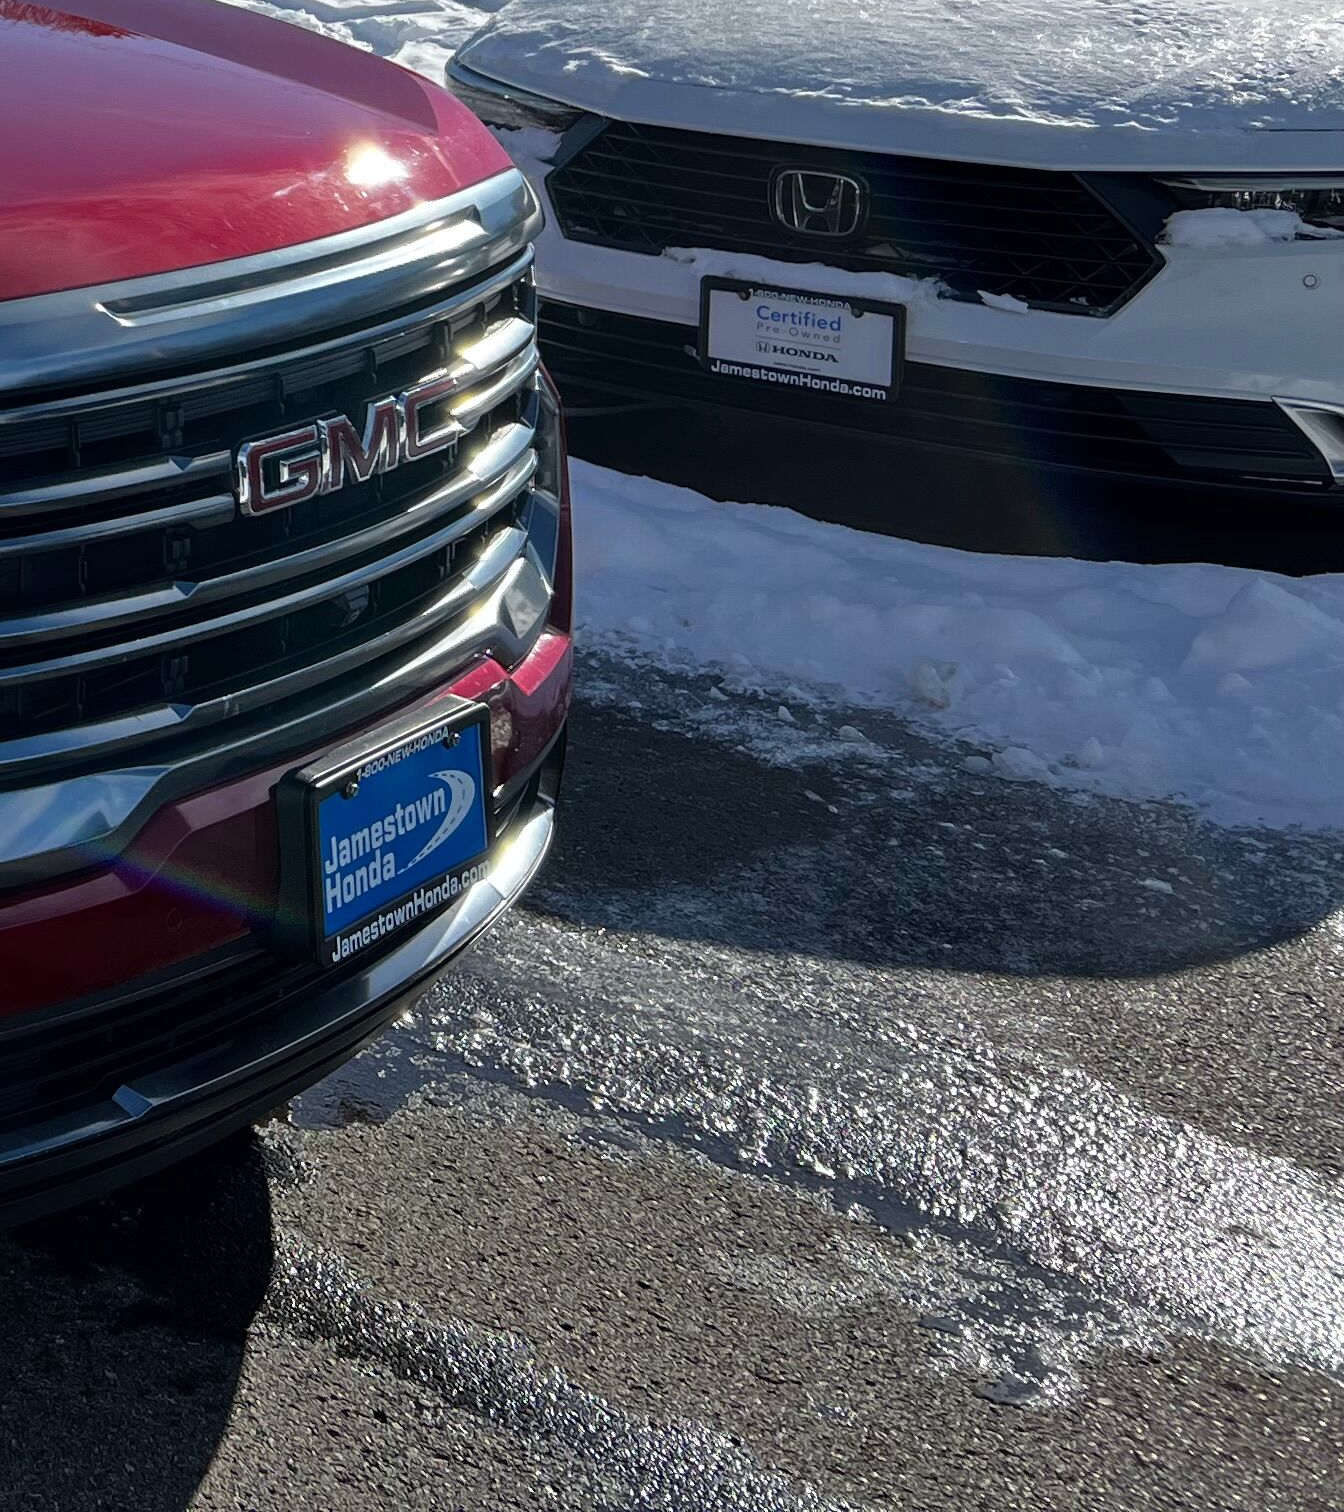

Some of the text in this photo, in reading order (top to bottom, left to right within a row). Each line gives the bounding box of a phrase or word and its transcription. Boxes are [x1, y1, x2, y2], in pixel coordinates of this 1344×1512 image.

[756, 305, 841, 331] Certified
[756, 321, 841, 344] Pre-Owned
[710, 359, 887, 401] JamestownHonda.com
[772, 345, 840, 364] HONDA
[236, 377, 460, 518] GMC
[355, 725, 450, 782] 1-800-NEW-HONDA
[324, 787, 447, 875] Jamestown
[325, 848, 397, 914] Honda
[331, 859, 493, 963] JamestownHonda.com
